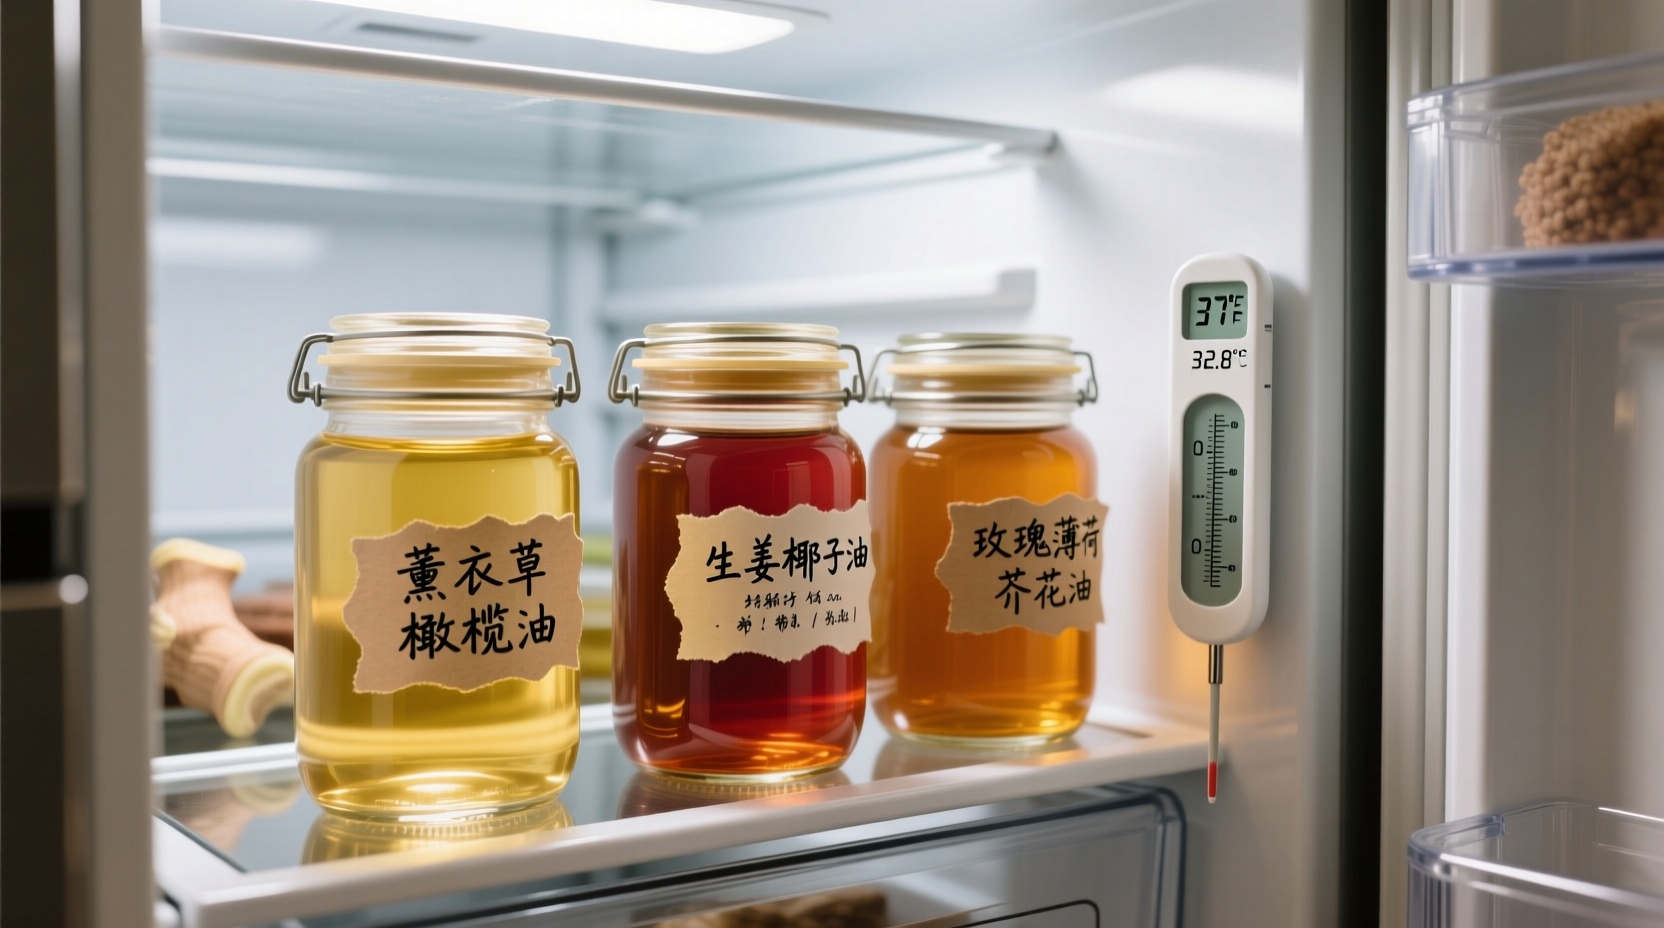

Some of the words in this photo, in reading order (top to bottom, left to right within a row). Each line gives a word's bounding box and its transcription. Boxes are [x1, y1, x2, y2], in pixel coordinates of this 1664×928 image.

[706, 533, 868, 584] 生姜椰子油
[972, 515, 1100, 560] 玫瑰薄荷
[397, 538, 546, 604] 薰衣草
[994, 567, 1092, 616] 芥花油
[398, 603, 556, 660] 橄榄油
